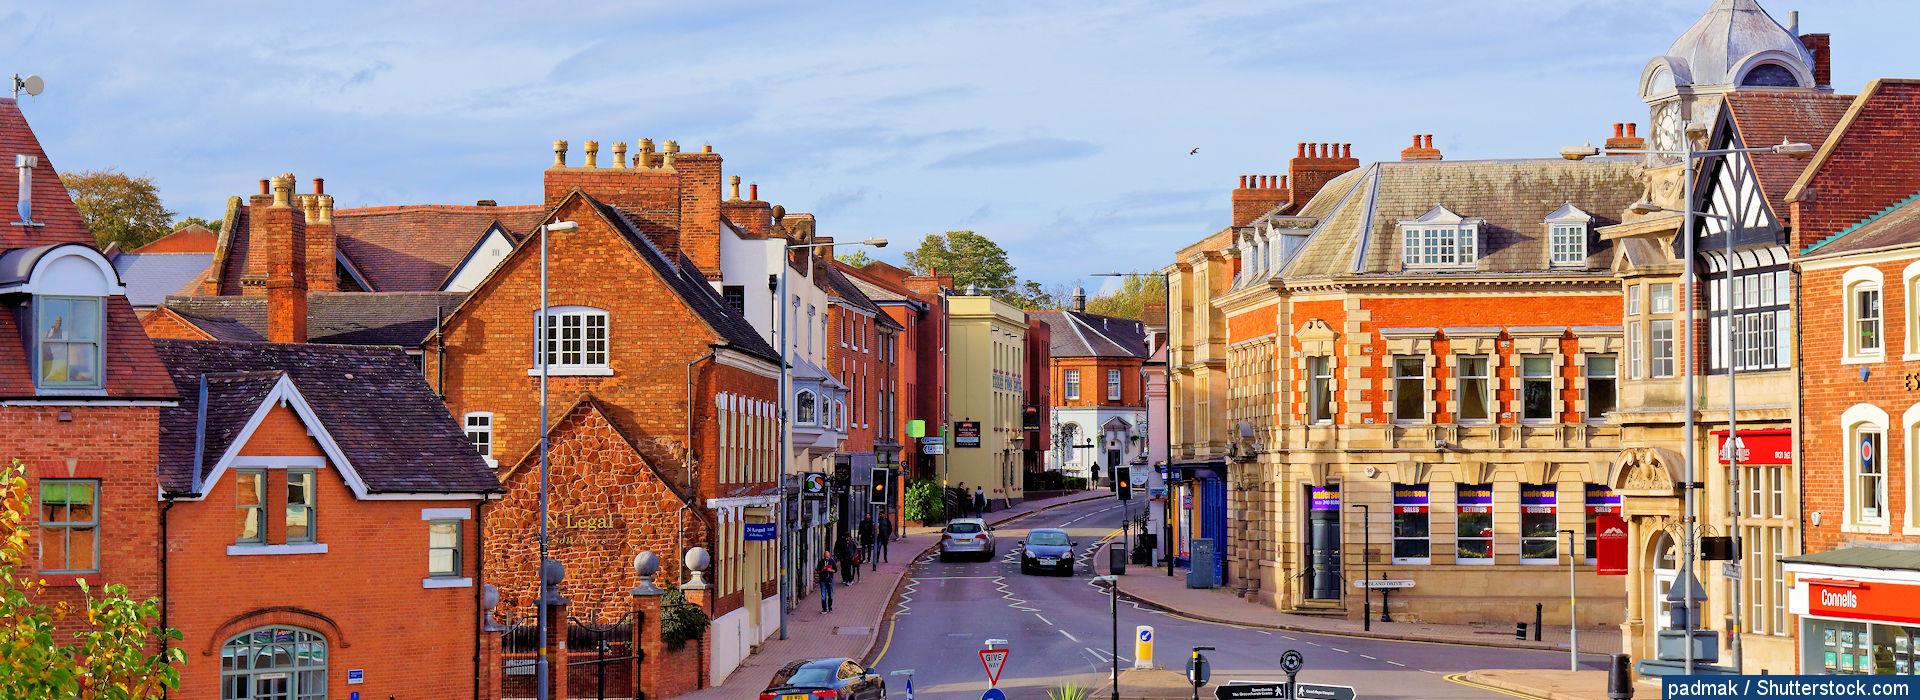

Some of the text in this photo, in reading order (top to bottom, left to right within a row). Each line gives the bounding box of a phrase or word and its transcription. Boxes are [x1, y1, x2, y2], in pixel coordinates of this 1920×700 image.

[1395, 490, 1427, 498] anderson
[1458, 490, 1491, 498] anderson
[1522, 490, 1555, 498] anderson
[1526, 506, 1552, 514] SURVEYS
[546, 512, 614, 531] N Legal
[1821, 588, 1857, 609] Connells
